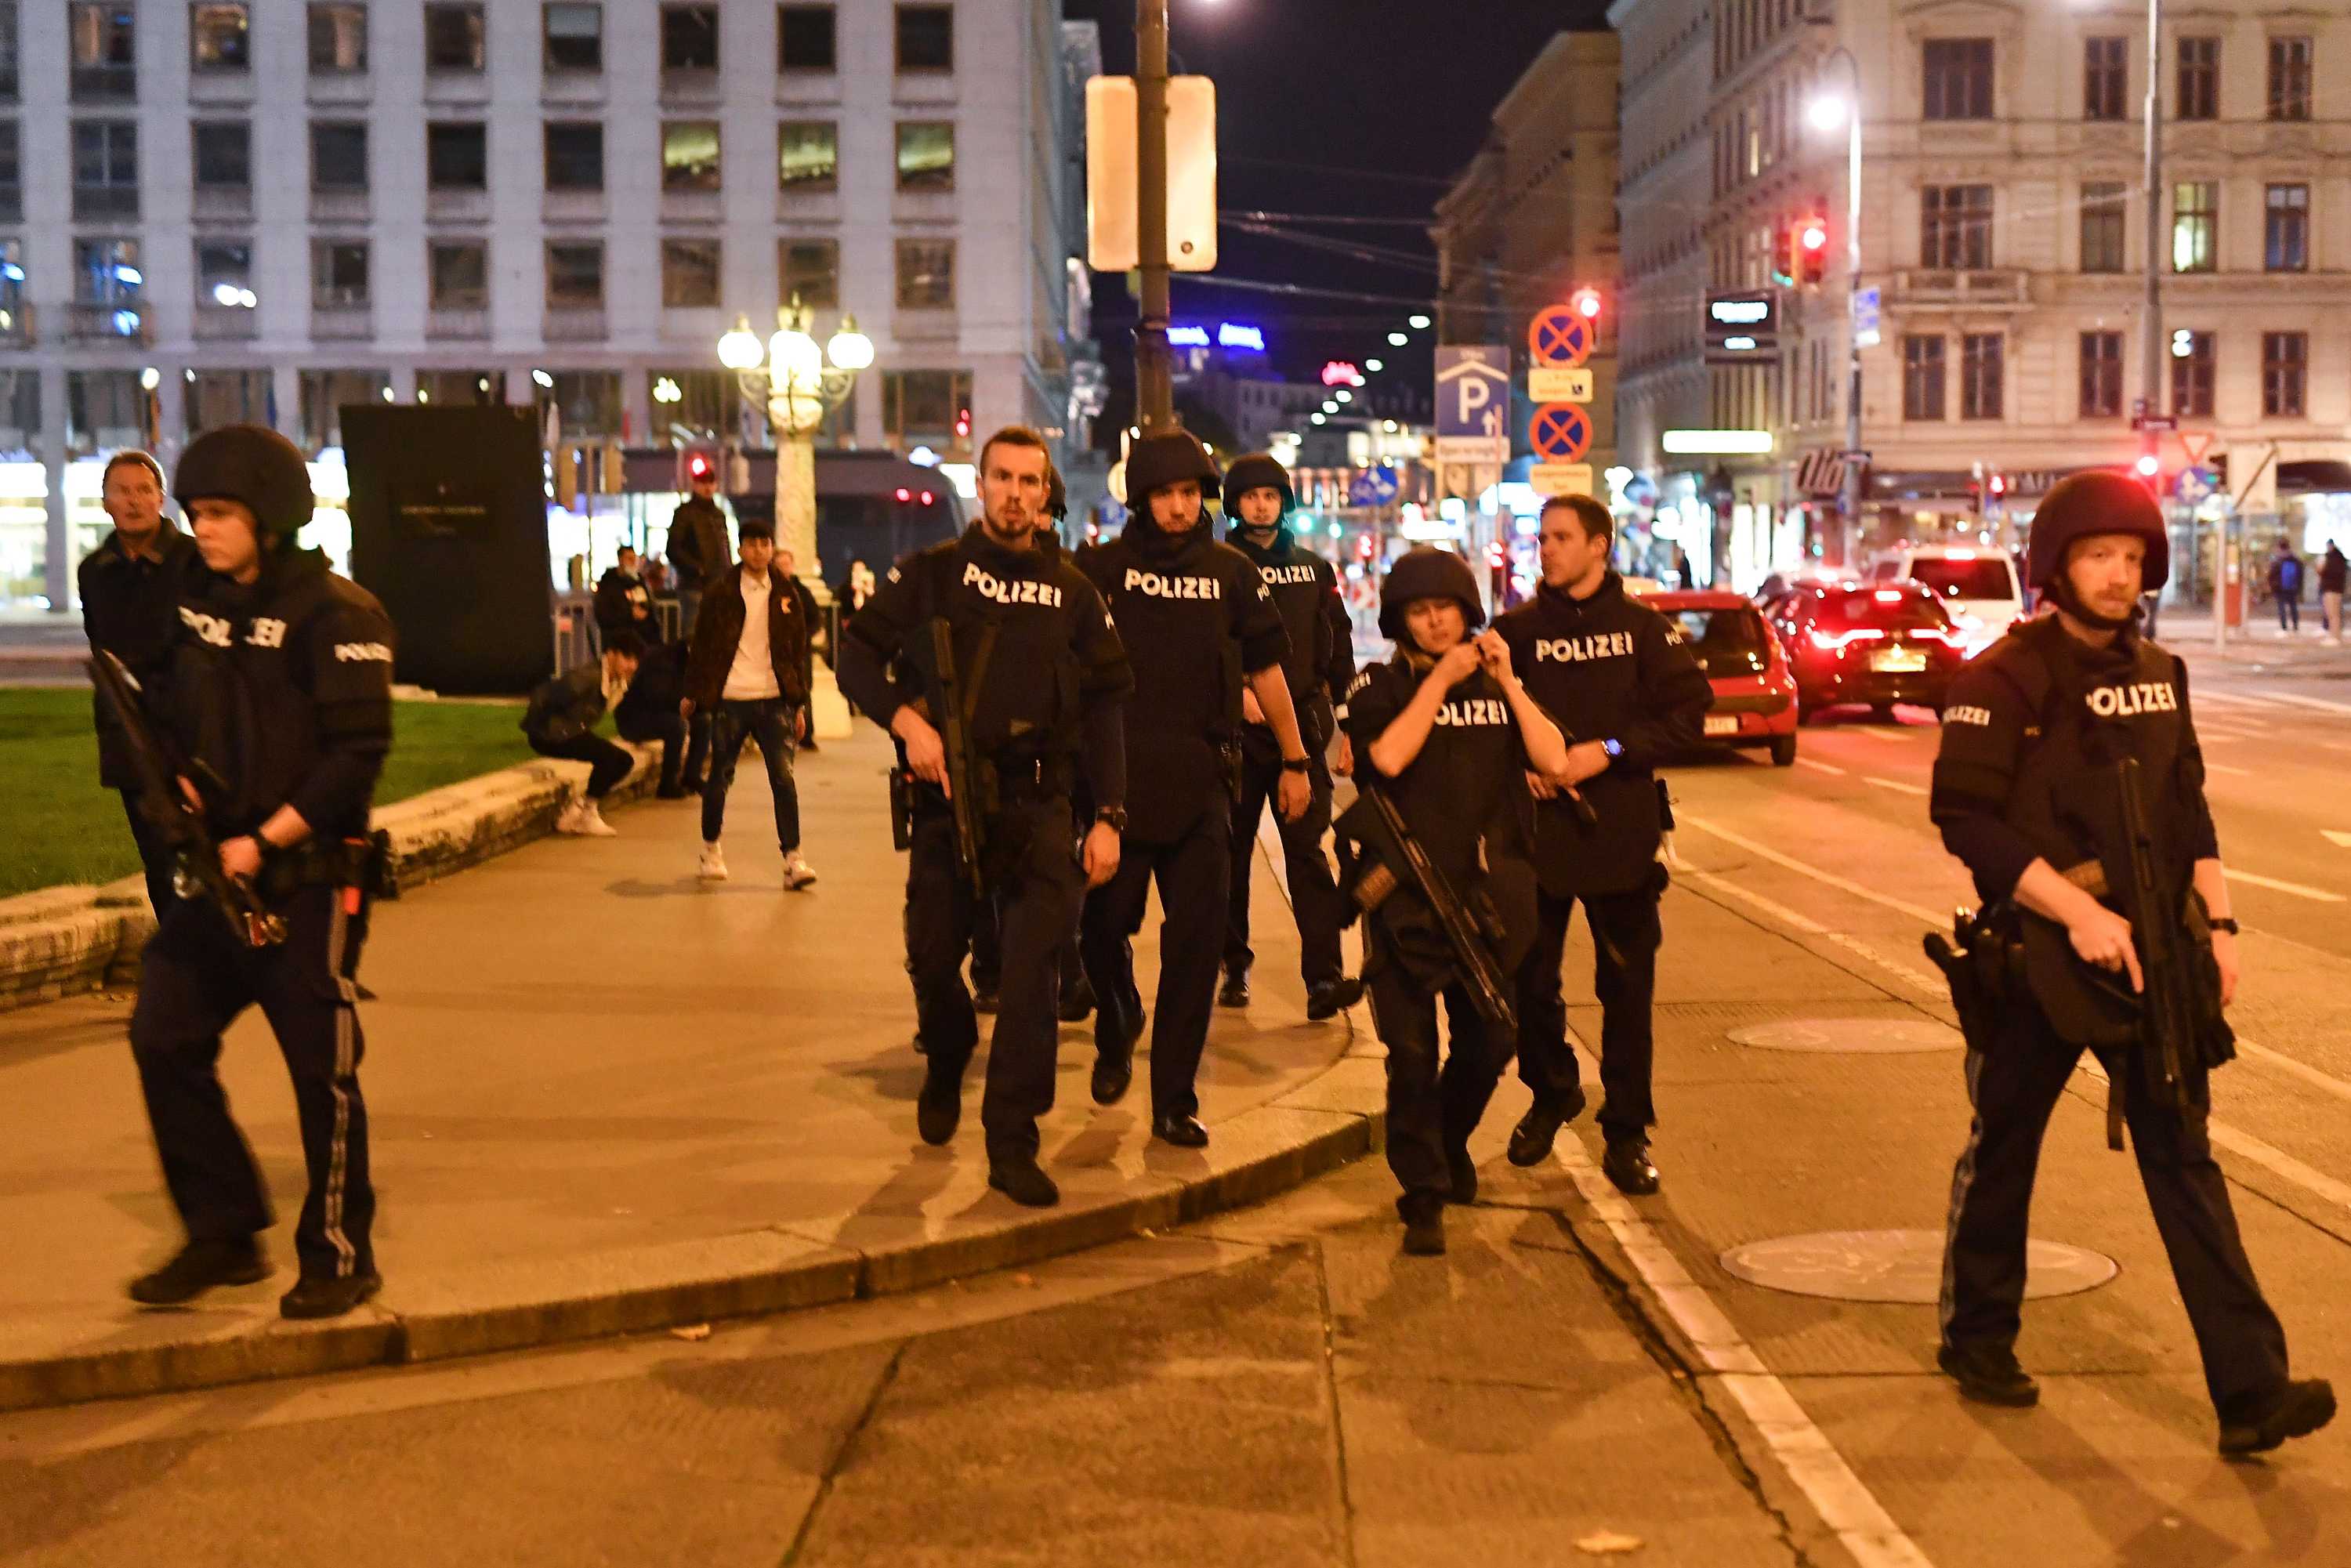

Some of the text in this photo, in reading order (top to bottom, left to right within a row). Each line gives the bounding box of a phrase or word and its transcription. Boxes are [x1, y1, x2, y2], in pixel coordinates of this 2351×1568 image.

[1458, 376, 1490, 425] P
[962, 562, 1062, 608] POLIZEI
[1124, 567, 1221, 599] POLIZEI
[1256, 564, 1317, 585] OLIZEI
[1535, 631, 1634, 662] POLIZEI
[1434, 699, 1509, 726] OLIZEI
